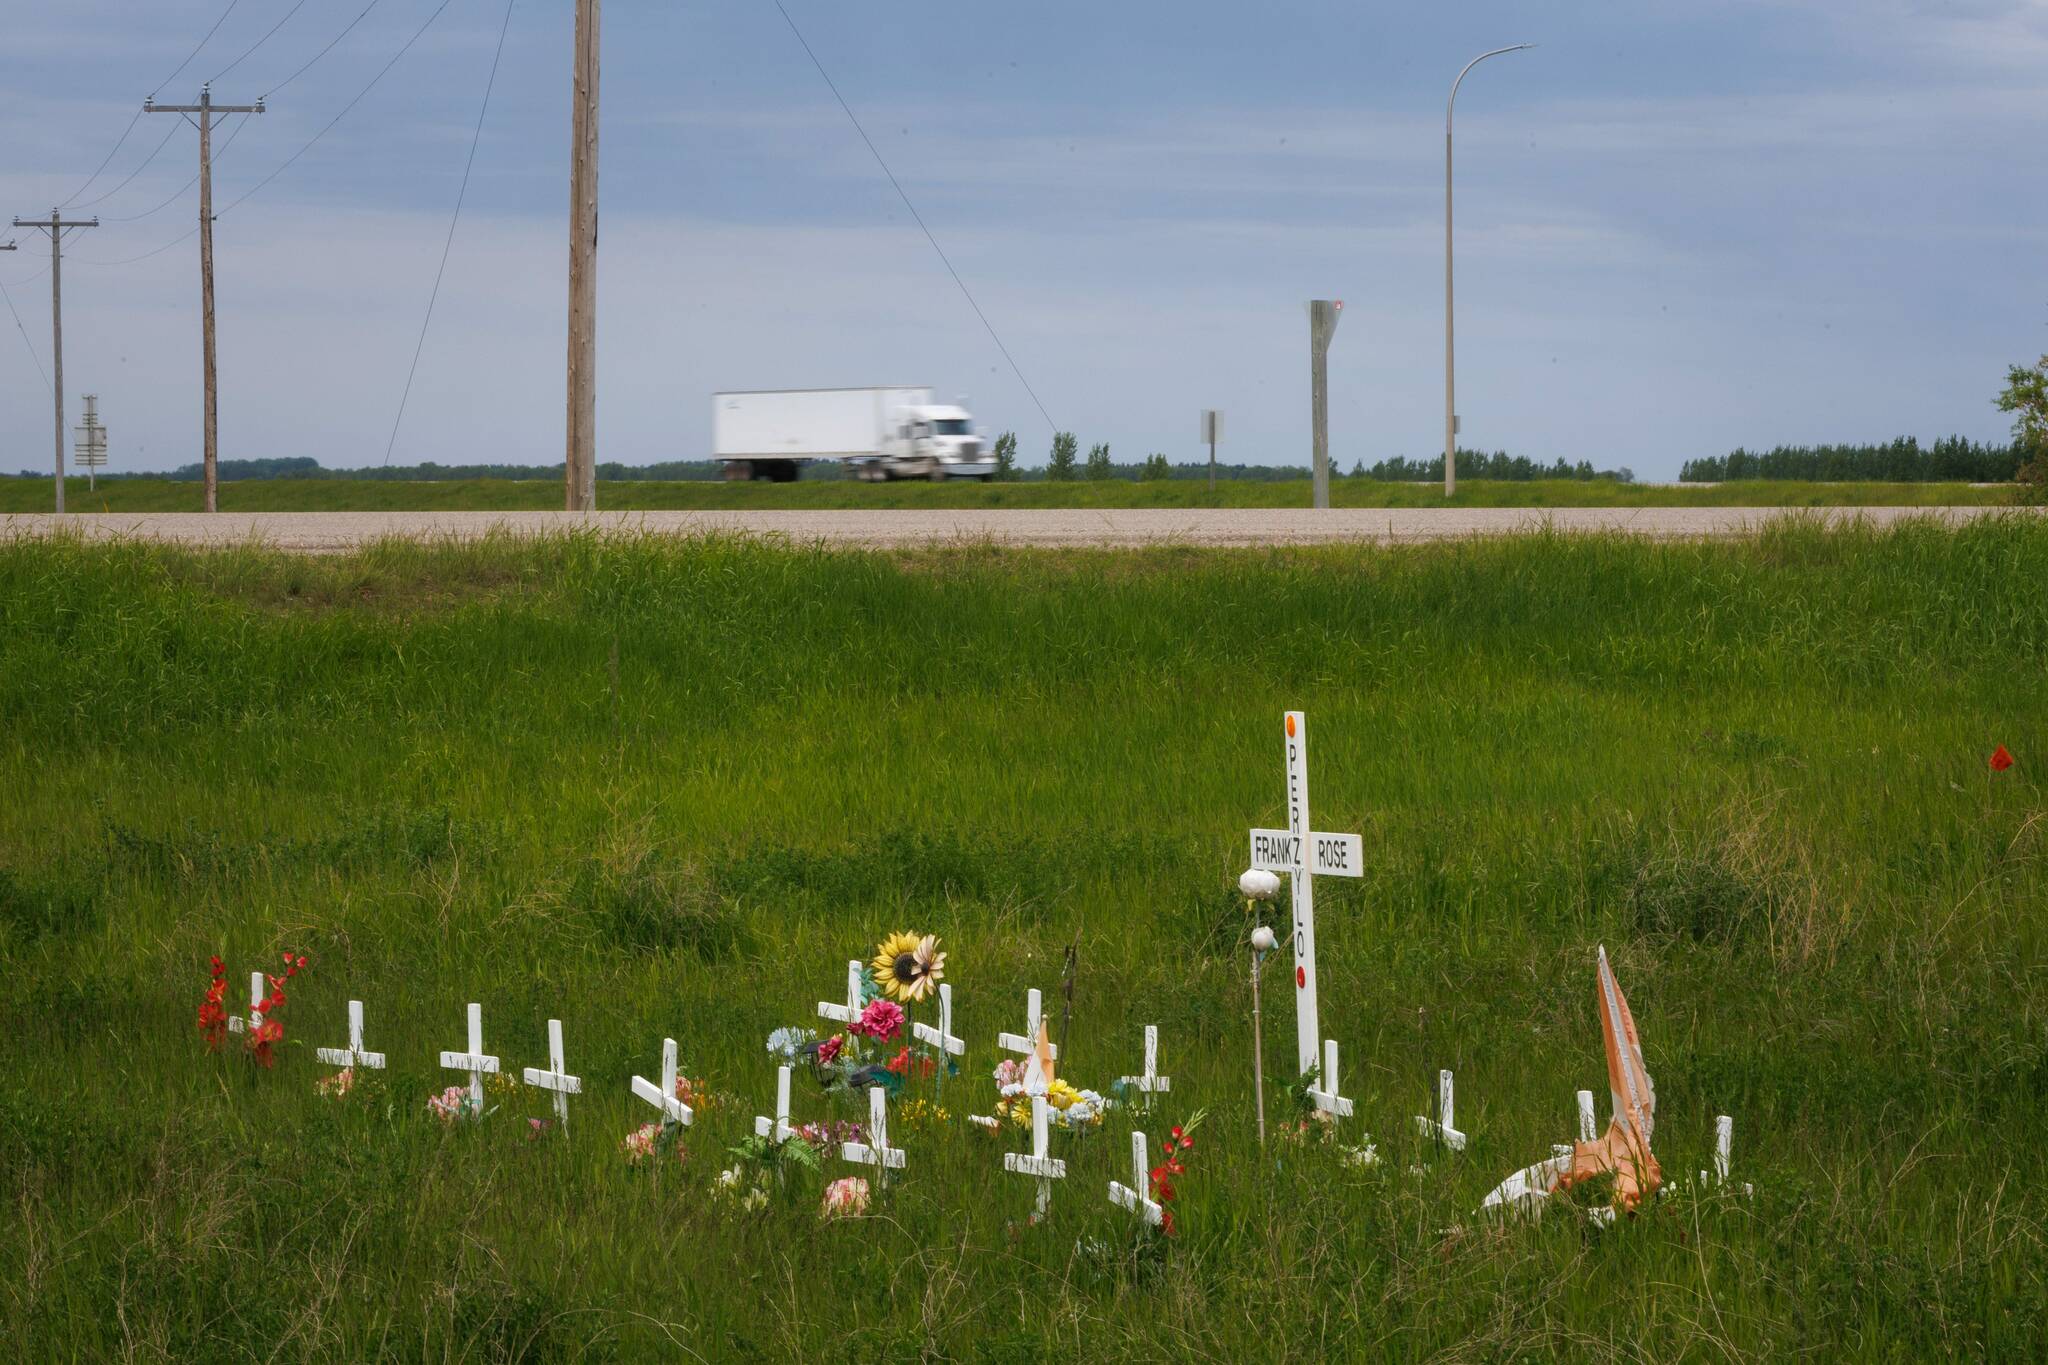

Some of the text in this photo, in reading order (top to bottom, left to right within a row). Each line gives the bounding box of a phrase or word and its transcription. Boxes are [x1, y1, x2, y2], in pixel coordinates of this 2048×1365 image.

[1255, 836, 1348, 869] FRANK ROSE
[1289, 744, 1304, 958] PERZYLO
